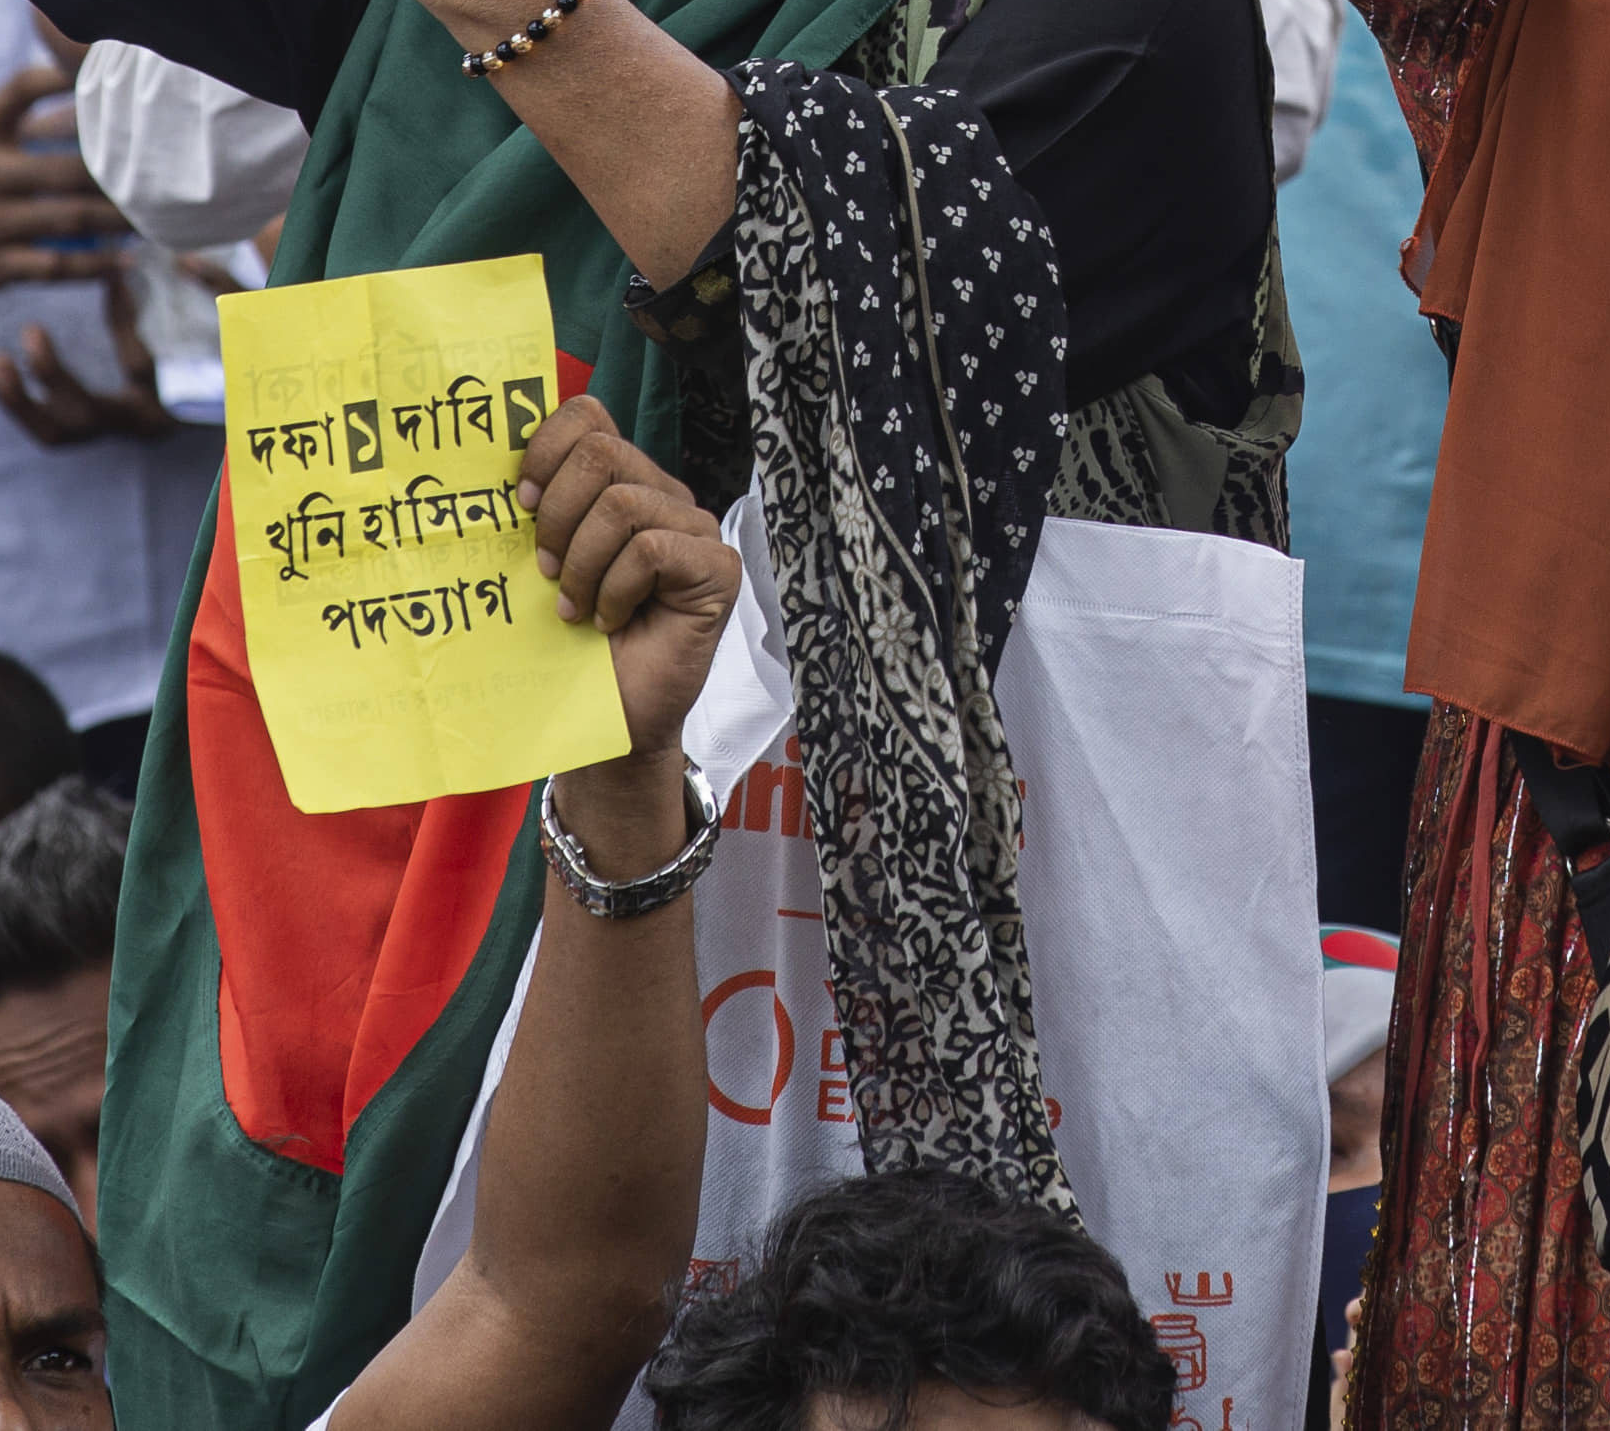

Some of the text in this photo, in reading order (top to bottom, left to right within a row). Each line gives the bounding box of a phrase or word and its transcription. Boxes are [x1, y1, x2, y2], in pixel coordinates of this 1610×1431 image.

[246, 412, 335, 475] দফা
[345, 405, 380, 468] ১
[391, 375, 495, 452] দাবি
[265, 491, 346, 582] খুনি
[321, 571, 514, 650] পদত্যাগ
